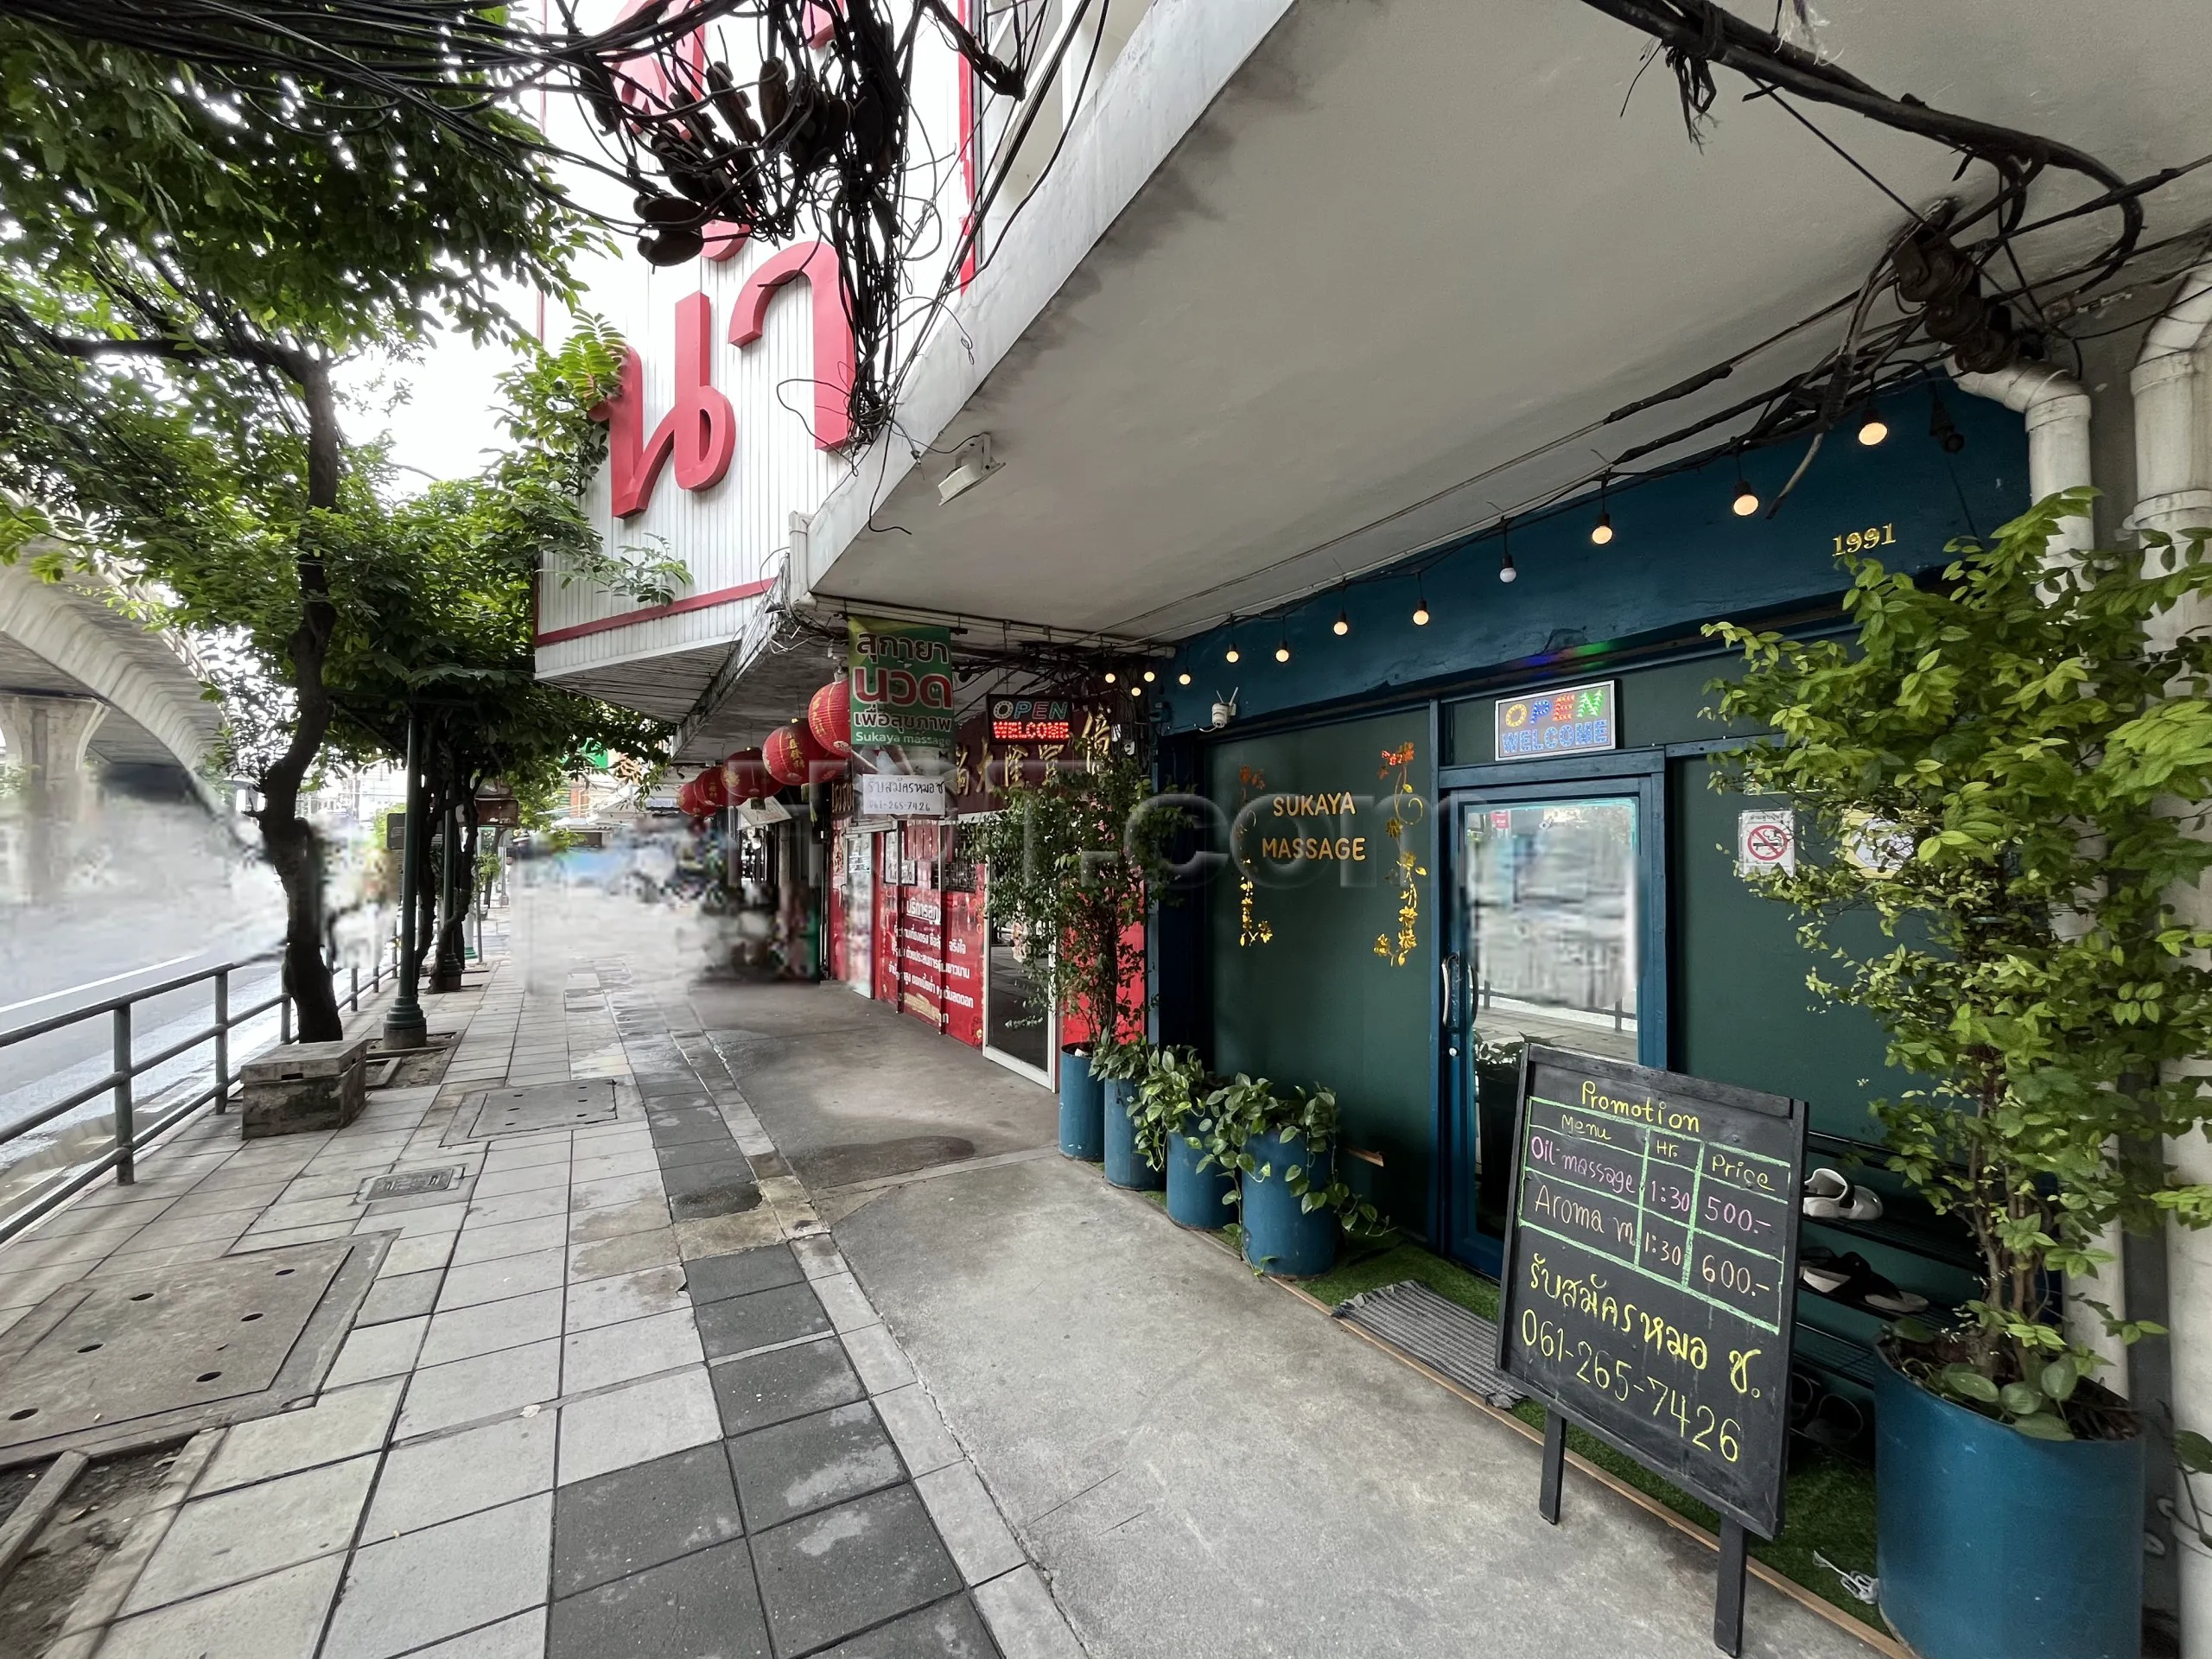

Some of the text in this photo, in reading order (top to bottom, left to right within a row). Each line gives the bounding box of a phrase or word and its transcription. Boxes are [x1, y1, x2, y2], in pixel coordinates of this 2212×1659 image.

[1832, 522, 1897, 556] 1991
[856, 632, 950, 664] สุกายา
[852, 665, 953, 710] นวด
[854, 703, 951, 734] เพื่อสุขภาพ
[993, 700, 1069, 720] OPEN
[1505, 690, 1604, 728] OPEN
[855, 731, 951, 748] Sukaya massage
[993, 721, 1070, 740] WELCOME
[1502, 719, 1608, 754] WELCOME
[1273, 791, 1356, 817] SUKAYA
[1262, 836, 1366, 861] MASSAGE
[1581, 1080, 1700, 1133] Promotion
[1561, 1114, 1611, 1141] Menu
[1712, 1154, 1775, 1192] Price
[1650, 1180, 1690, 1211] 1:30
[1705, 1196, 1771, 1234] 500.-
[1535, 1185, 1605, 1234] Aroma
[1644, 1231, 1681, 1266] 1:30
[1522, 1309, 1741, 1462] 061-265-7426
